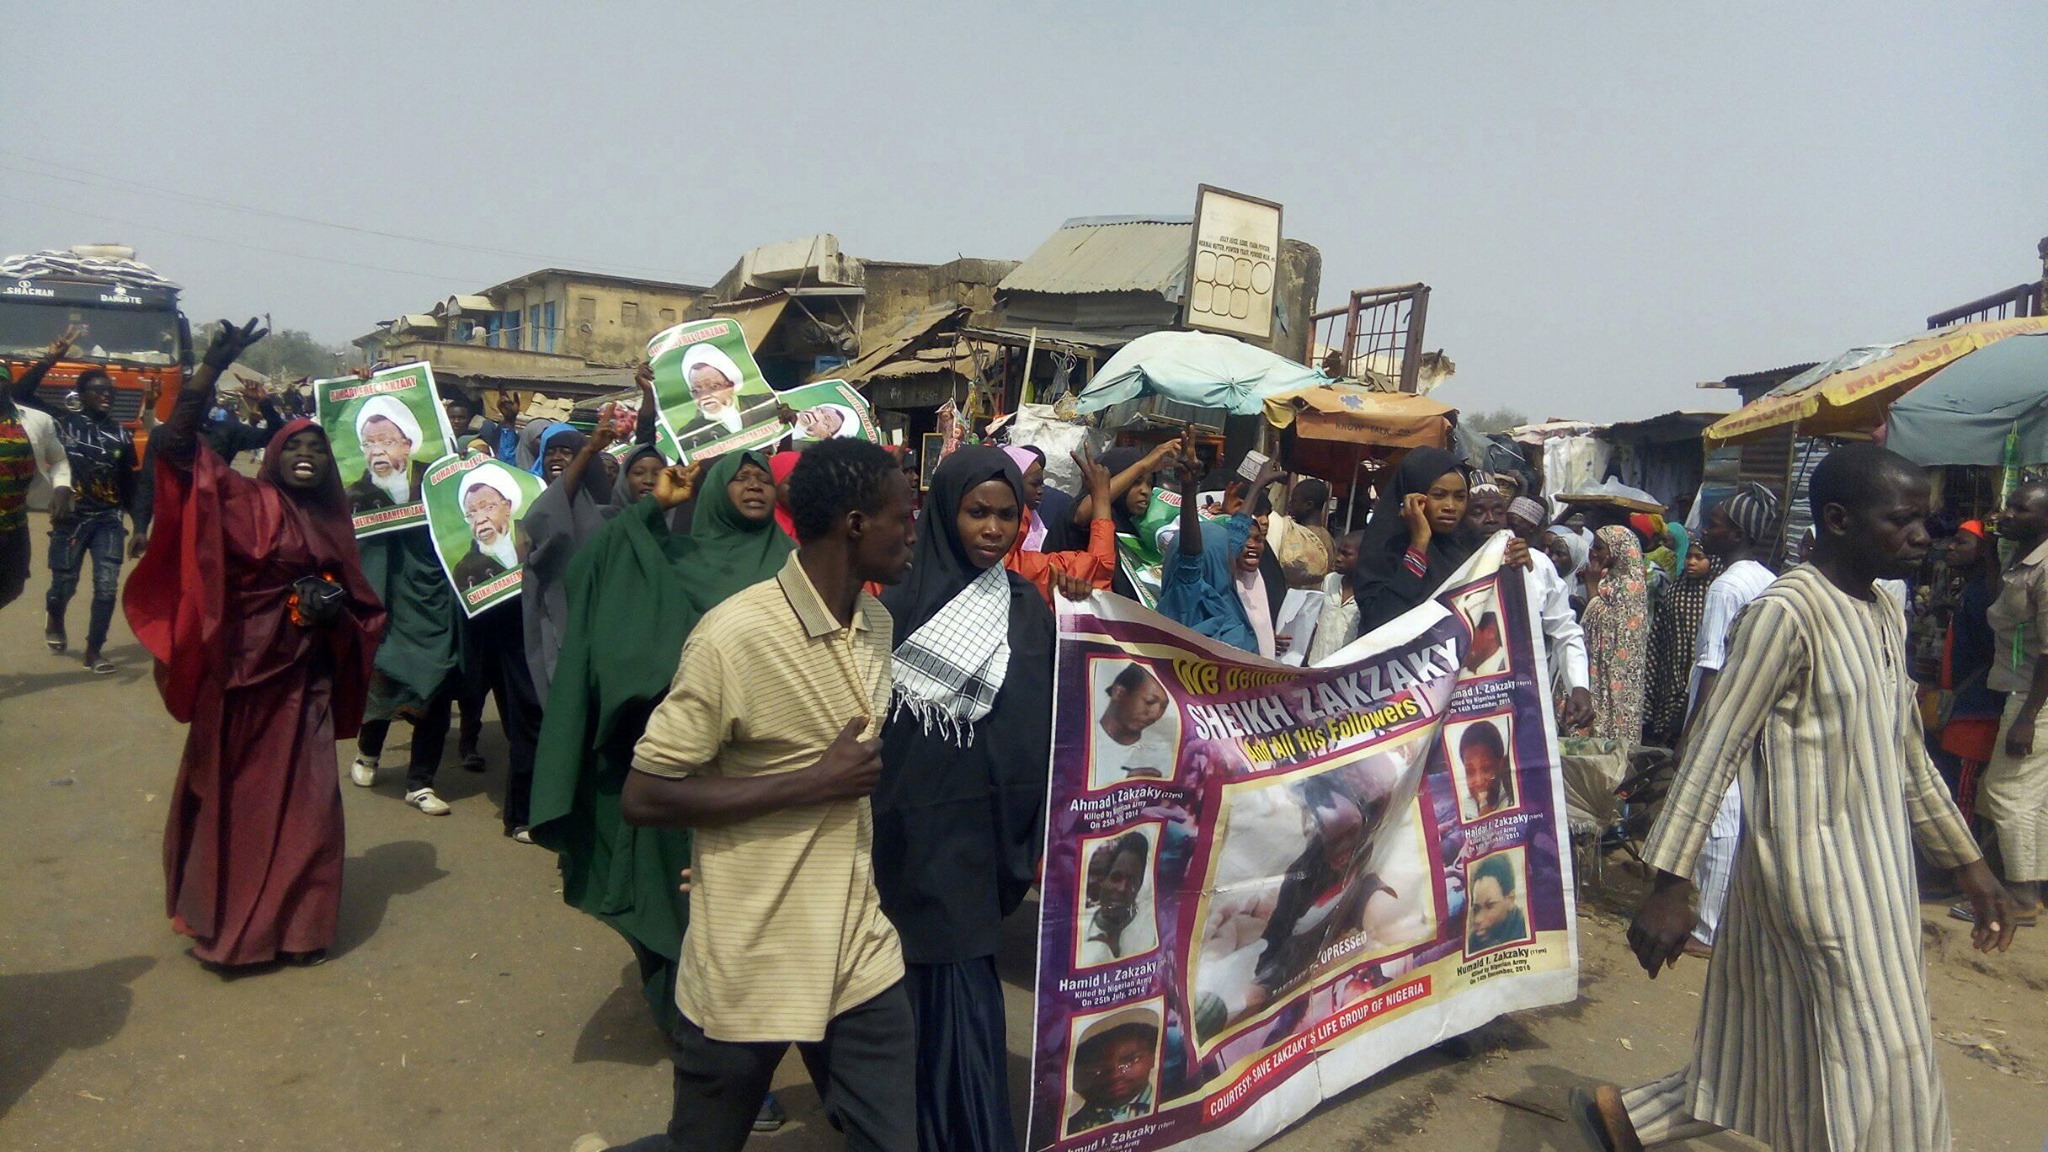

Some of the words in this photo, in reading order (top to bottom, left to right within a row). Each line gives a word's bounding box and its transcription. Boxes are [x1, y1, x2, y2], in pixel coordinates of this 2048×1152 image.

[6, 286, 54, 297] SHACMAN
[100, 294, 142, 305] DANGOTE
[431, 462, 459, 484] BUHARI
[1159, 491, 1183, 506] BUHA
[353, 514, 376, 528] HEIKH
[1172, 656, 1219, 695] We
[1186, 695, 1295, 741] SHEIKH
[1293, 638, 1460, 721] ZAKZAKY
[1484, 680, 1515, 694] Zakzaky
[1496, 691, 1508, 700] Army
[1243, 738, 1274, 763] And
[1271, 732, 1297, 759] All
[1298, 727, 1327, 755] His
[1326, 697, 1418, 744] Followers
[1070, 794, 1111, 811] Ahmad
[1118, 786, 1162, 803] Zakzaky
[1084, 810, 1105, 820] Killed
[1105, 809, 1113, 819] by
[1131, 799, 1147, 810] Army
[1090, 820, 1101, 829] On
[1494, 812, 1529, 828] Zakzaky
[1320, 930, 1367, 964] OPRESSED
[1493, 947, 1529, 962] Zakzaky
[1512, 958, 1528, 967] Army
[1515, 964, 1531, 973] 2015
[1059, 974, 1100, 992] Hamid
[1103, 972, 1110, 985] I.
[1114, 961, 1157, 982] Zakzaky
[1074, 989, 1096, 999] Killed
[1098, 988, 1106, 997] by
[1107, 979, 1134, 993] Nigerian
[1136, 975, 1153, 986] Army
[1081, 998, 1092, 1007] On
[1094, 995, 1111, 1006] 25th
[1128, 985, 1145, 997] 2014
[1210, 1074, 1252, 1117] COURTESY:
[1252, 1058, 1272, 1083] SAVE
[1317, 1019, 1338, 1041] LIFE
[1339, 1005, 1370, 1029] GROUP
[1371, 997, 1384, 1012] OF
[1385, 982, 1424, 1007] NIGERIA
[1111, 1123, 1157, 1144] Zakzaky
[1123, 1140, 1140, 1150] Army
